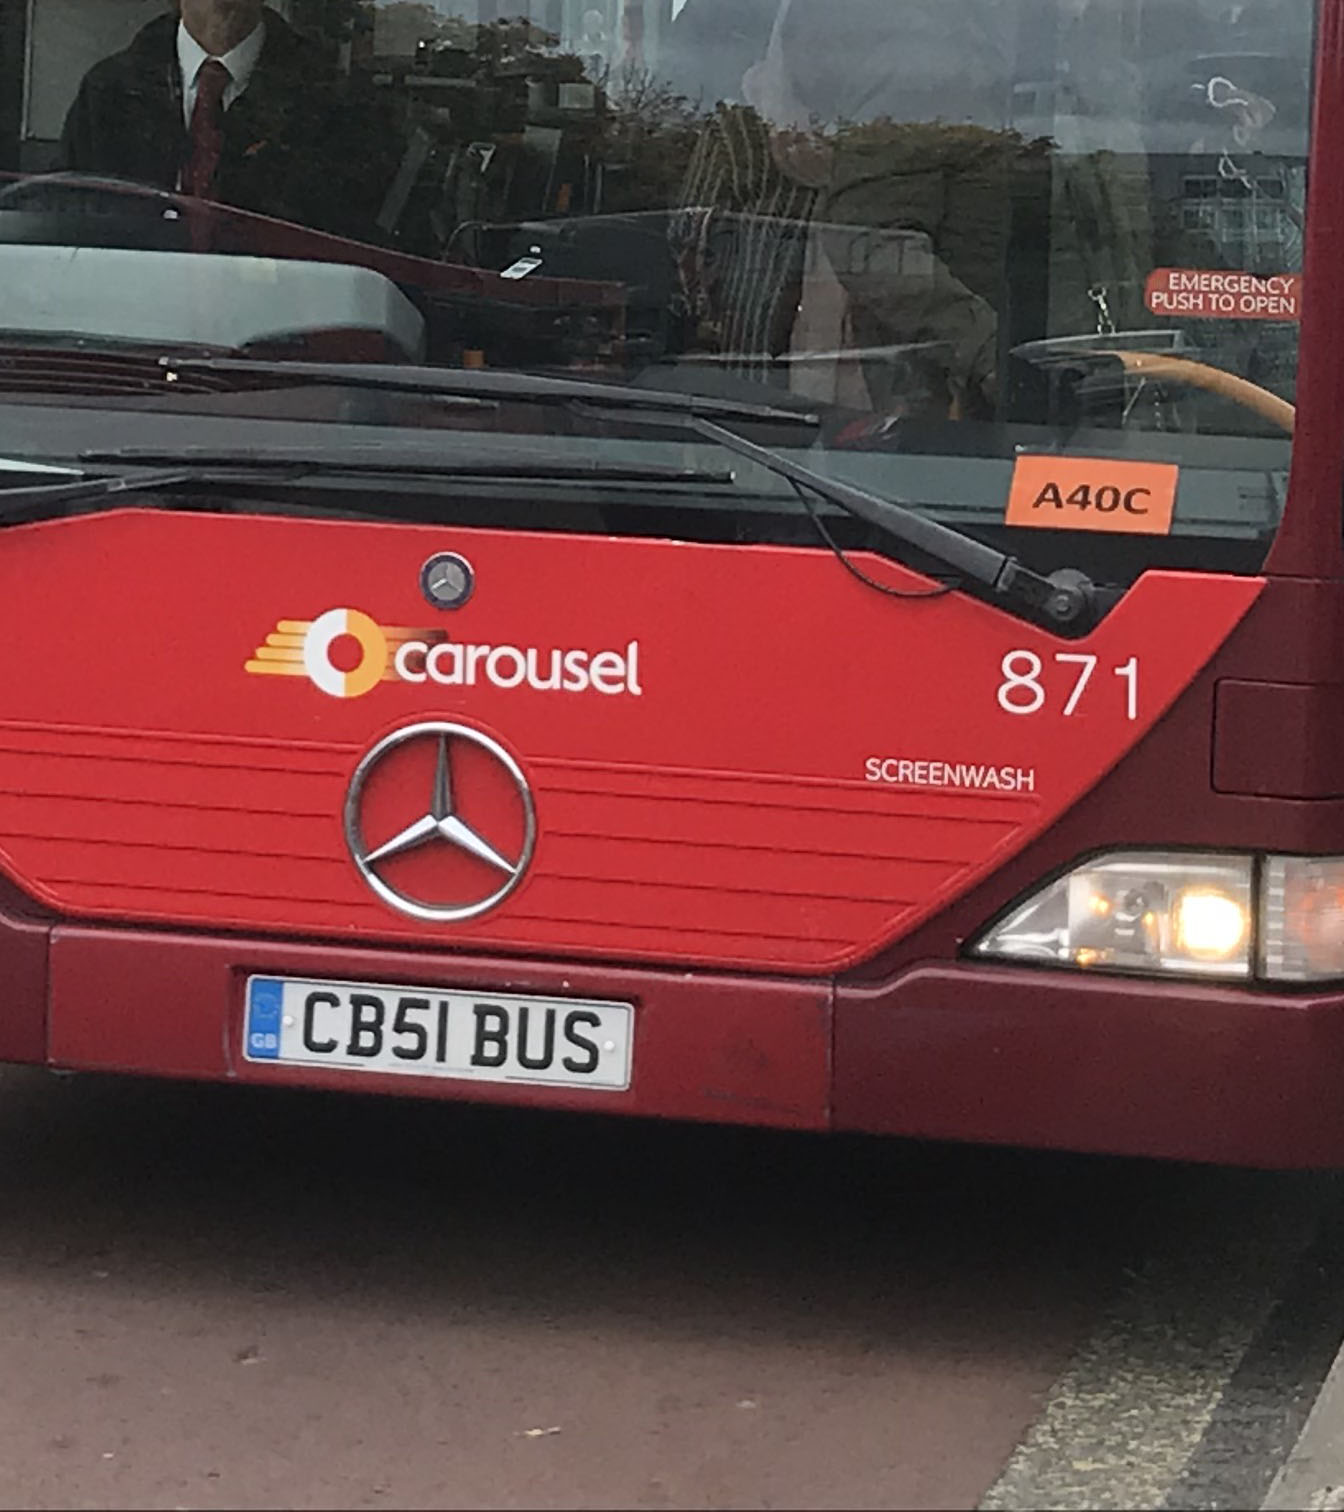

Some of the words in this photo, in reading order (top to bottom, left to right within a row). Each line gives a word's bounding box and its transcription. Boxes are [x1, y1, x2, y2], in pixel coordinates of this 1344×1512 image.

[1168, 272, 1294, 295] EMERGENCY
[1151, 291, 1204, 310] PUSH
[1208, 293, 1236, 311] TO
[1239, 294, 1296, 314] OPEN
[1032, 482, 1152, 515] A40C
[394, 640, 643, 696] carousel
[997, 649, 1139, 720] 871
[864, 756, 1035, 792] SCREENWASH
[250, 1032, 278, 1049] GB
[303, 991, 450, 1063] CB51
[470, 1003, 603, 1074] BUS
